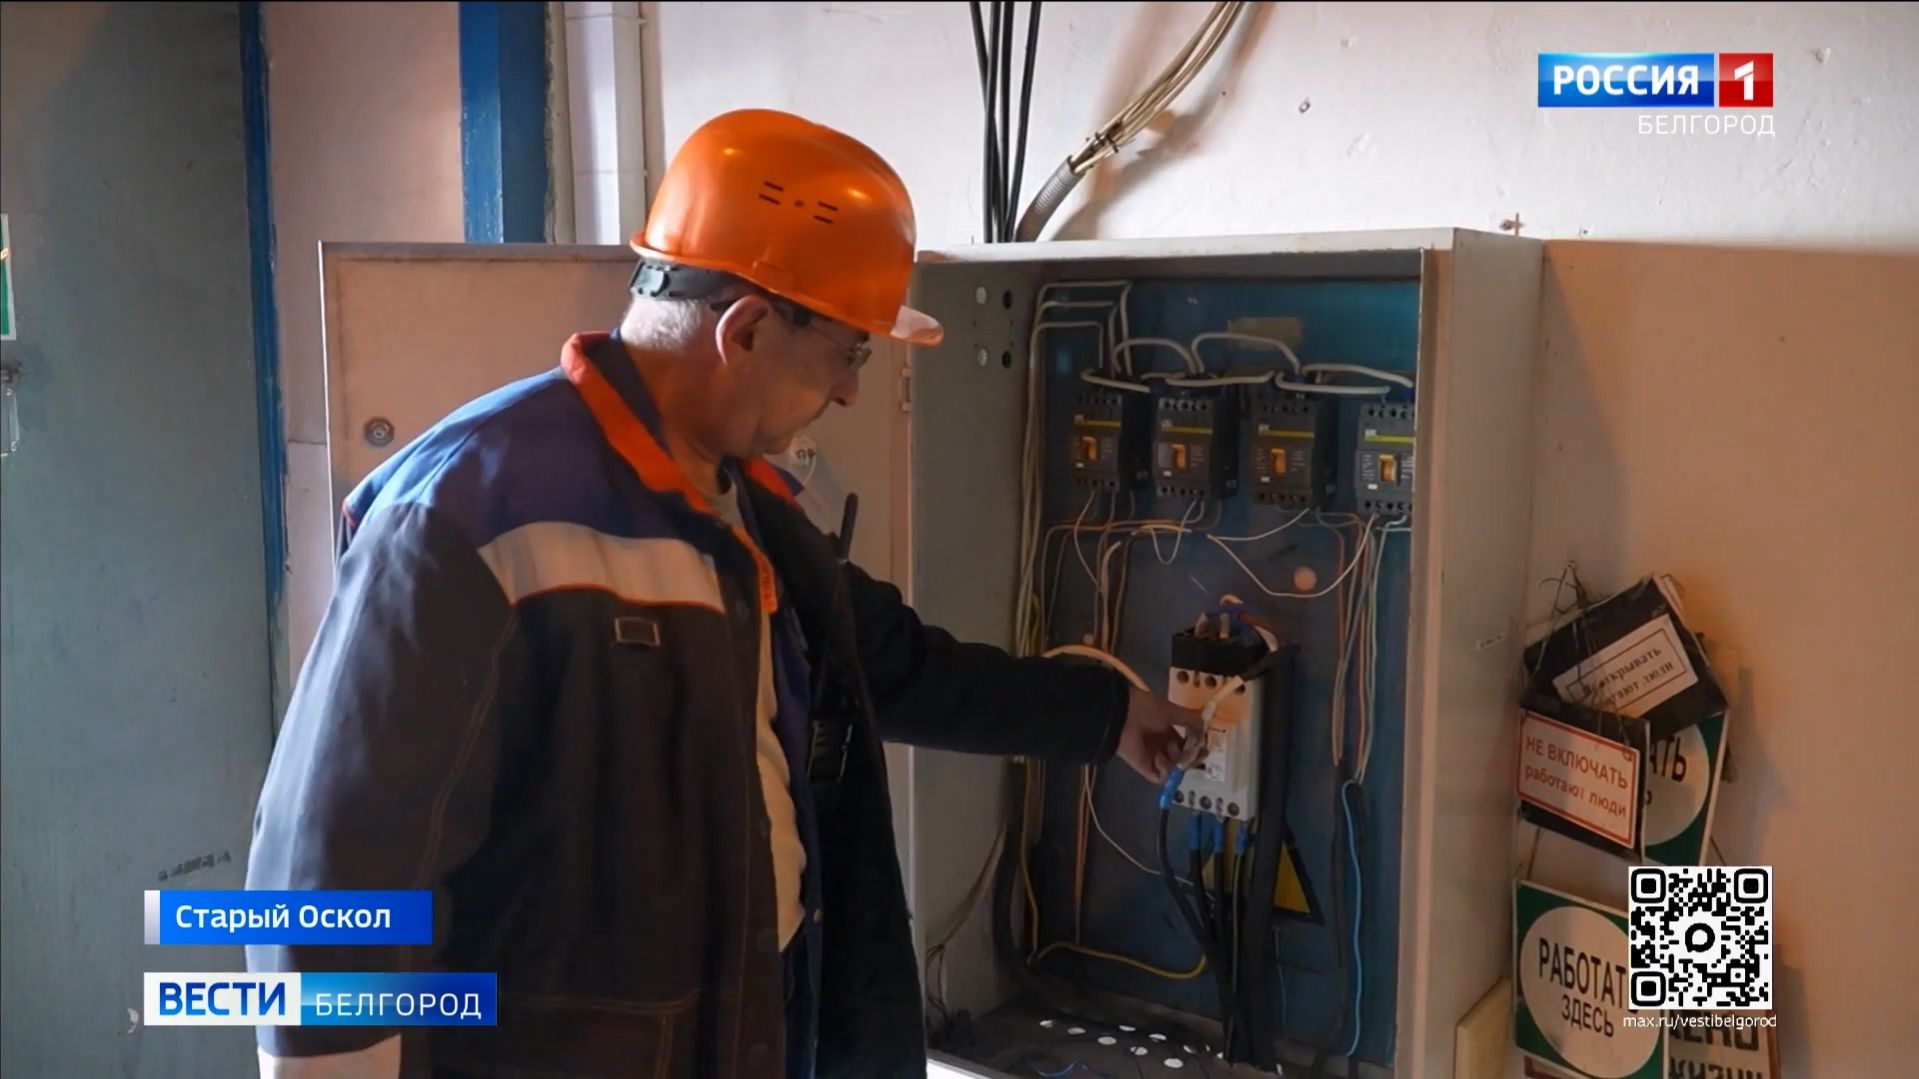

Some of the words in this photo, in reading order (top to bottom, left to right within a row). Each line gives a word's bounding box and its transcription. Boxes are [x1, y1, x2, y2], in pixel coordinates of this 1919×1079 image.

[1526, 735, 1545, 757] НЕ
[1548, 743, 1628, 790] ВКЛЮЧАТЬ
[1525, 766, 1584, 798] работают
[1589, 792, 1628, 818] люди
[1539, 937, 1638, 1013] РАБОТАТ
[1562, 994, 1614, 1037] ЗДЕСЬ
